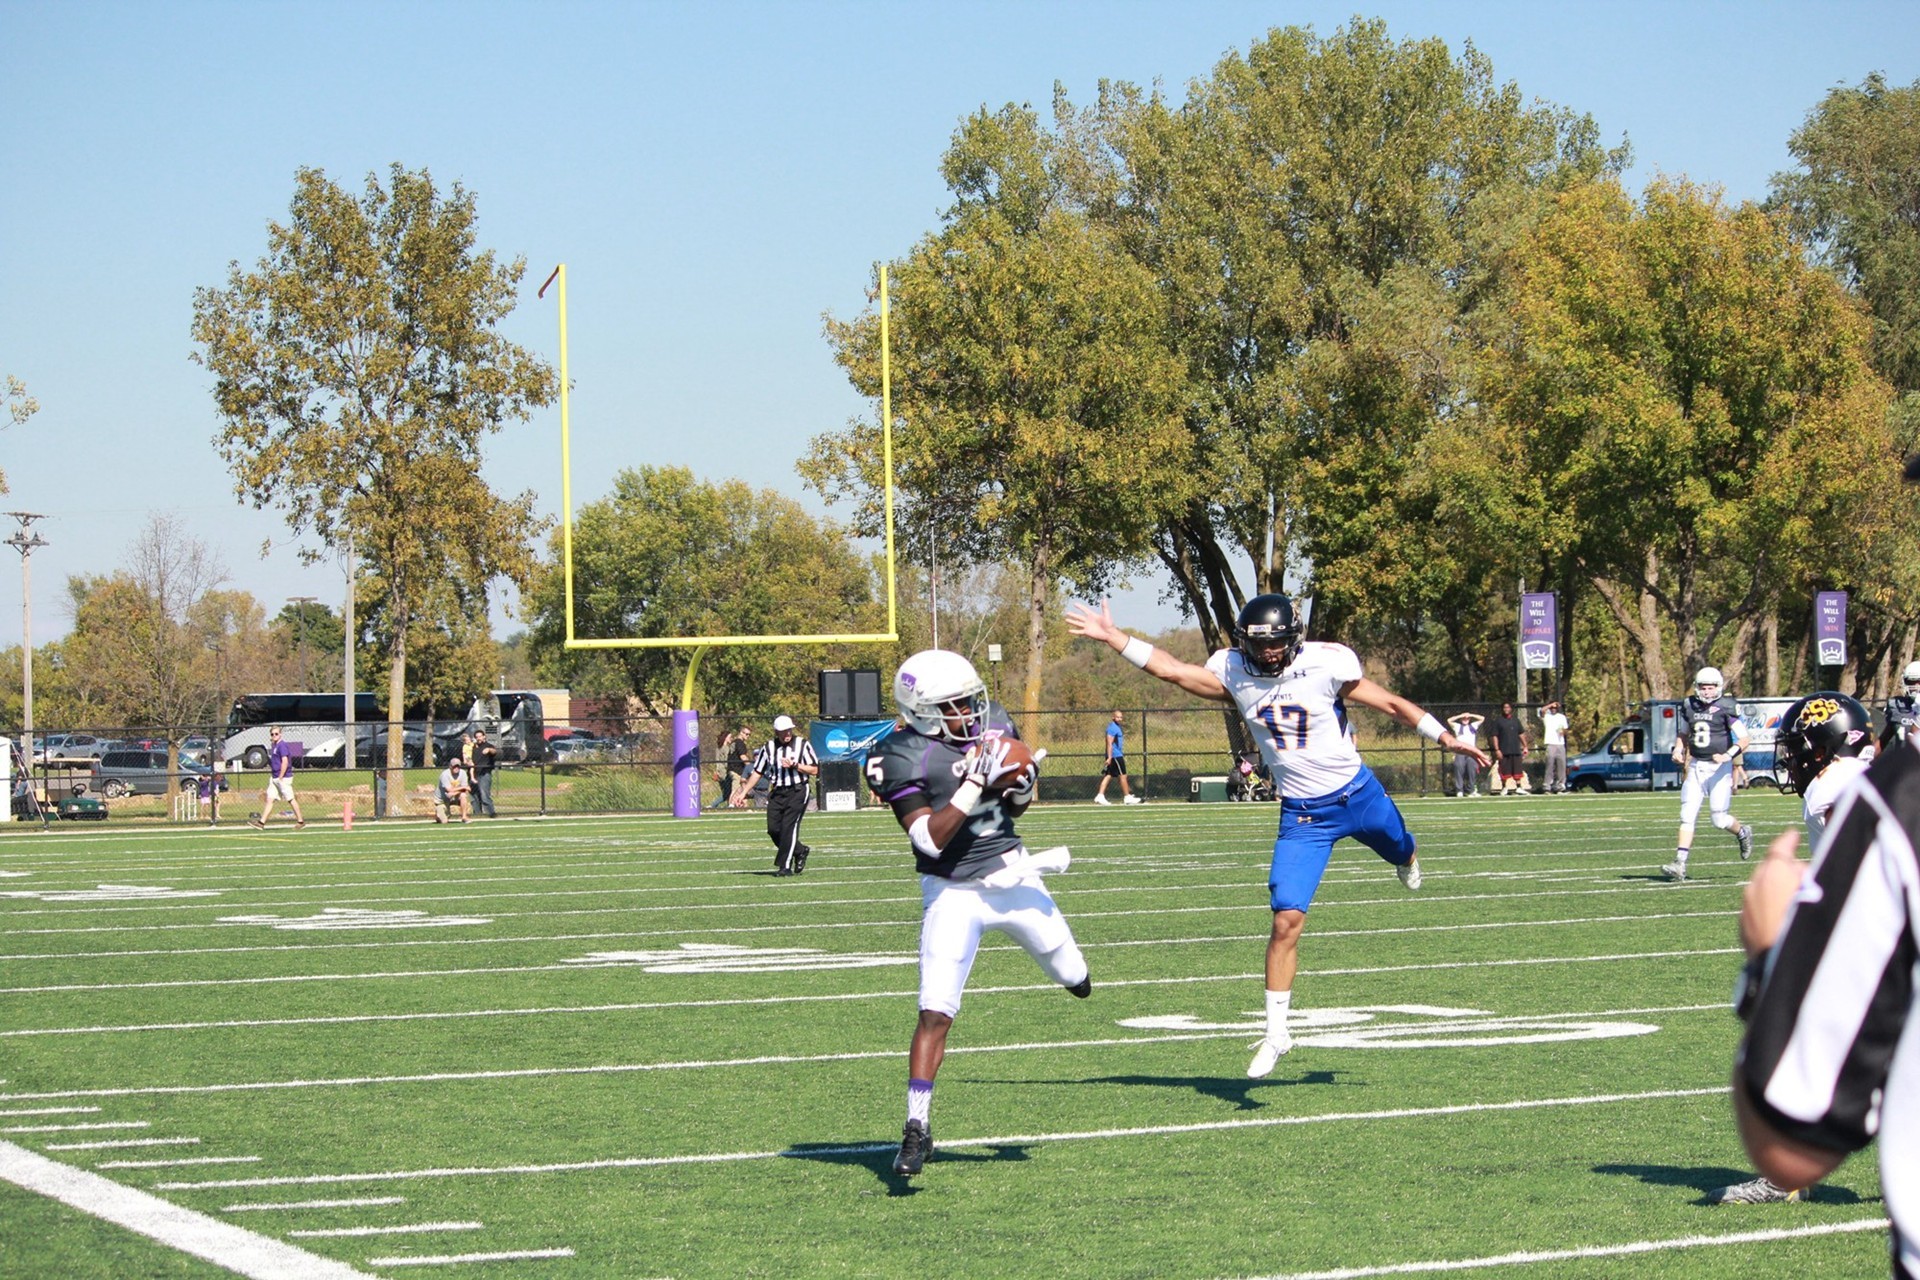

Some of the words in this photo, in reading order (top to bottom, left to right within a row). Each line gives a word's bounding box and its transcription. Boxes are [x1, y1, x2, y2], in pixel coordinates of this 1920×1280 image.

[1529, 609, 1545, 617] WILL
[1531, 600, 1544, 608] THE
[1823, 607, 1839, 615] WILL
[1256, 704, 1308, 752] 17
[1693, 721, 1711, 748] 8
[688, 746, 699, 809] CROWN
[866, 756, 884, 786] 5
